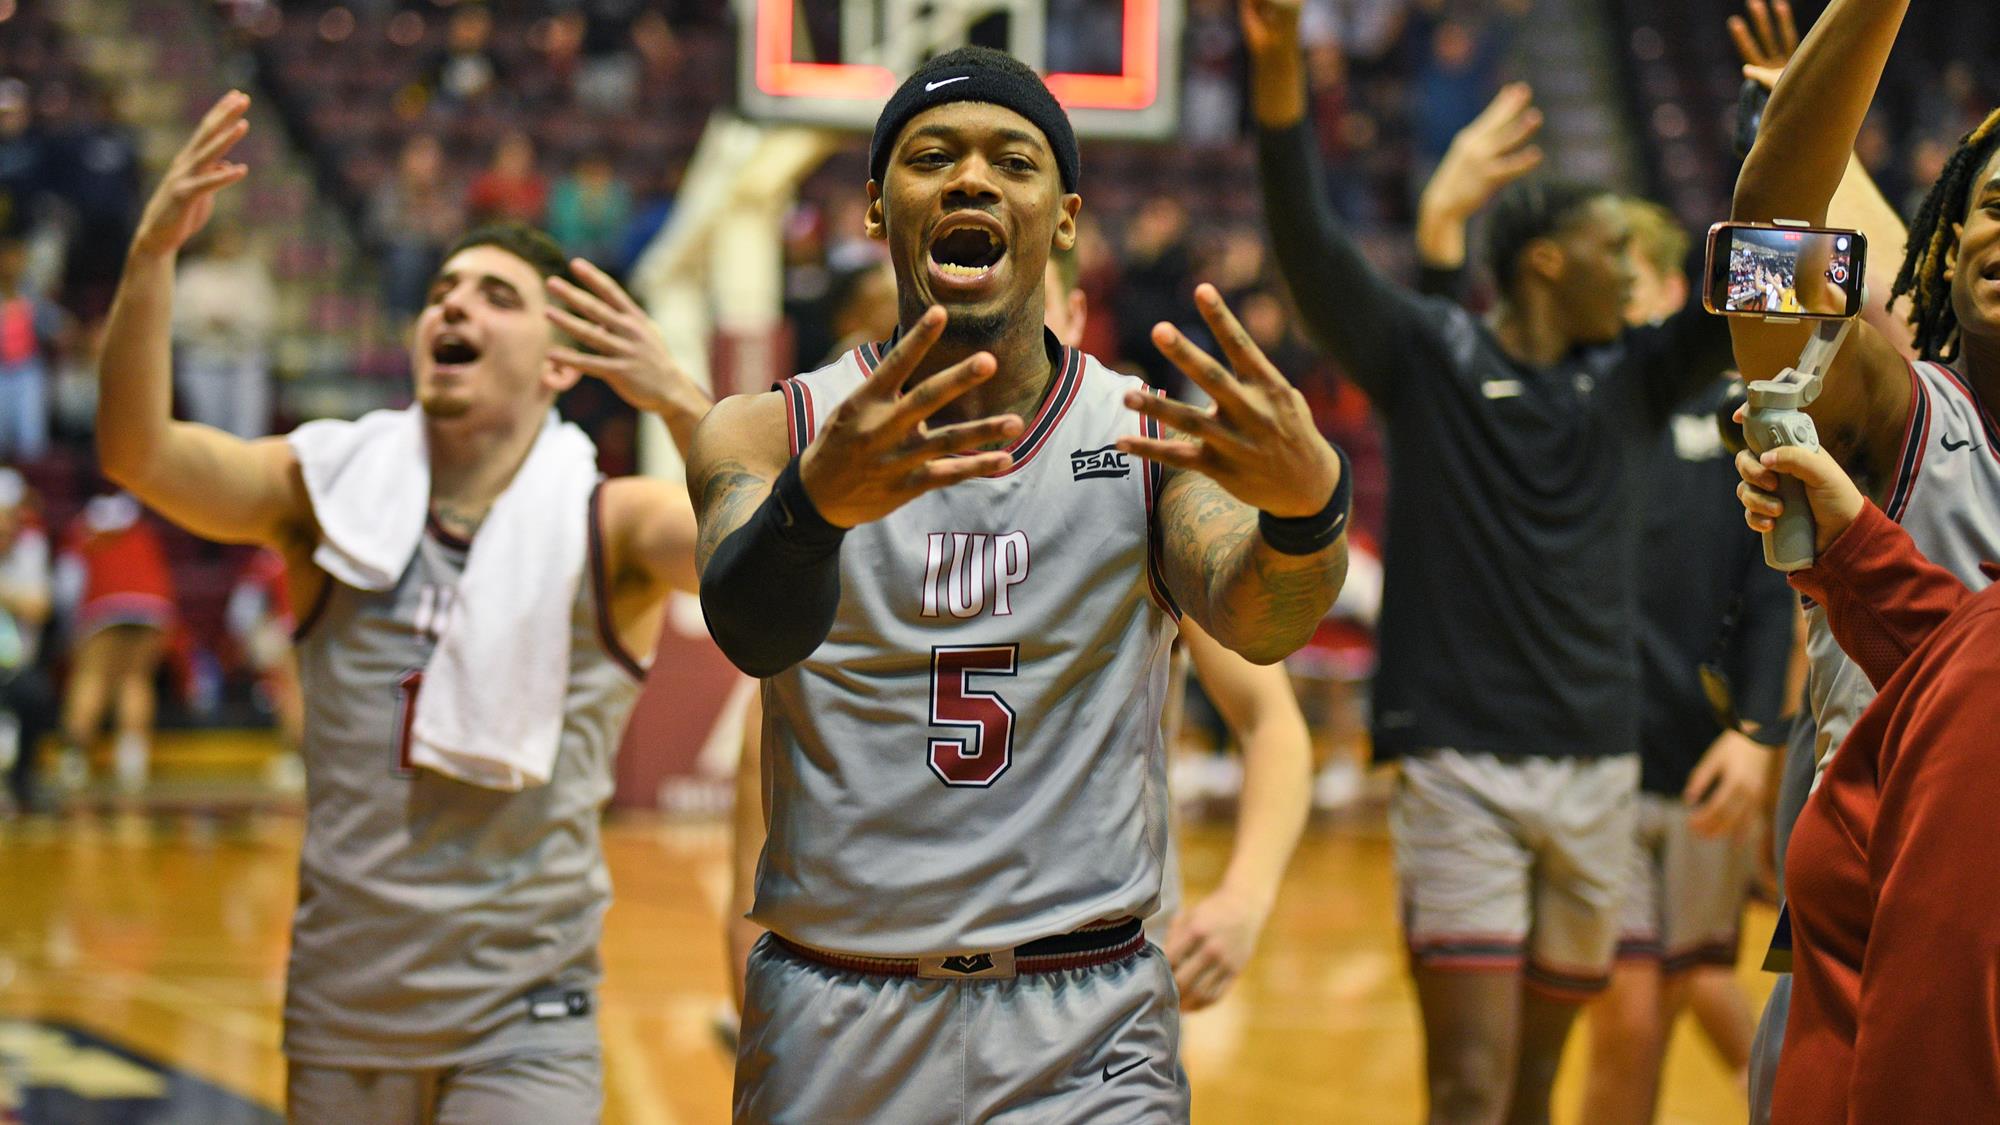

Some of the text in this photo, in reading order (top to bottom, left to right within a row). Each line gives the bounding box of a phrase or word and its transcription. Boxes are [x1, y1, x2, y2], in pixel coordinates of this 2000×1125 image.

[1071, 452, 1130, 474] PSAC
[920, 530, 1030, 619] IUP
[926, 642, 1020, 788] 5
